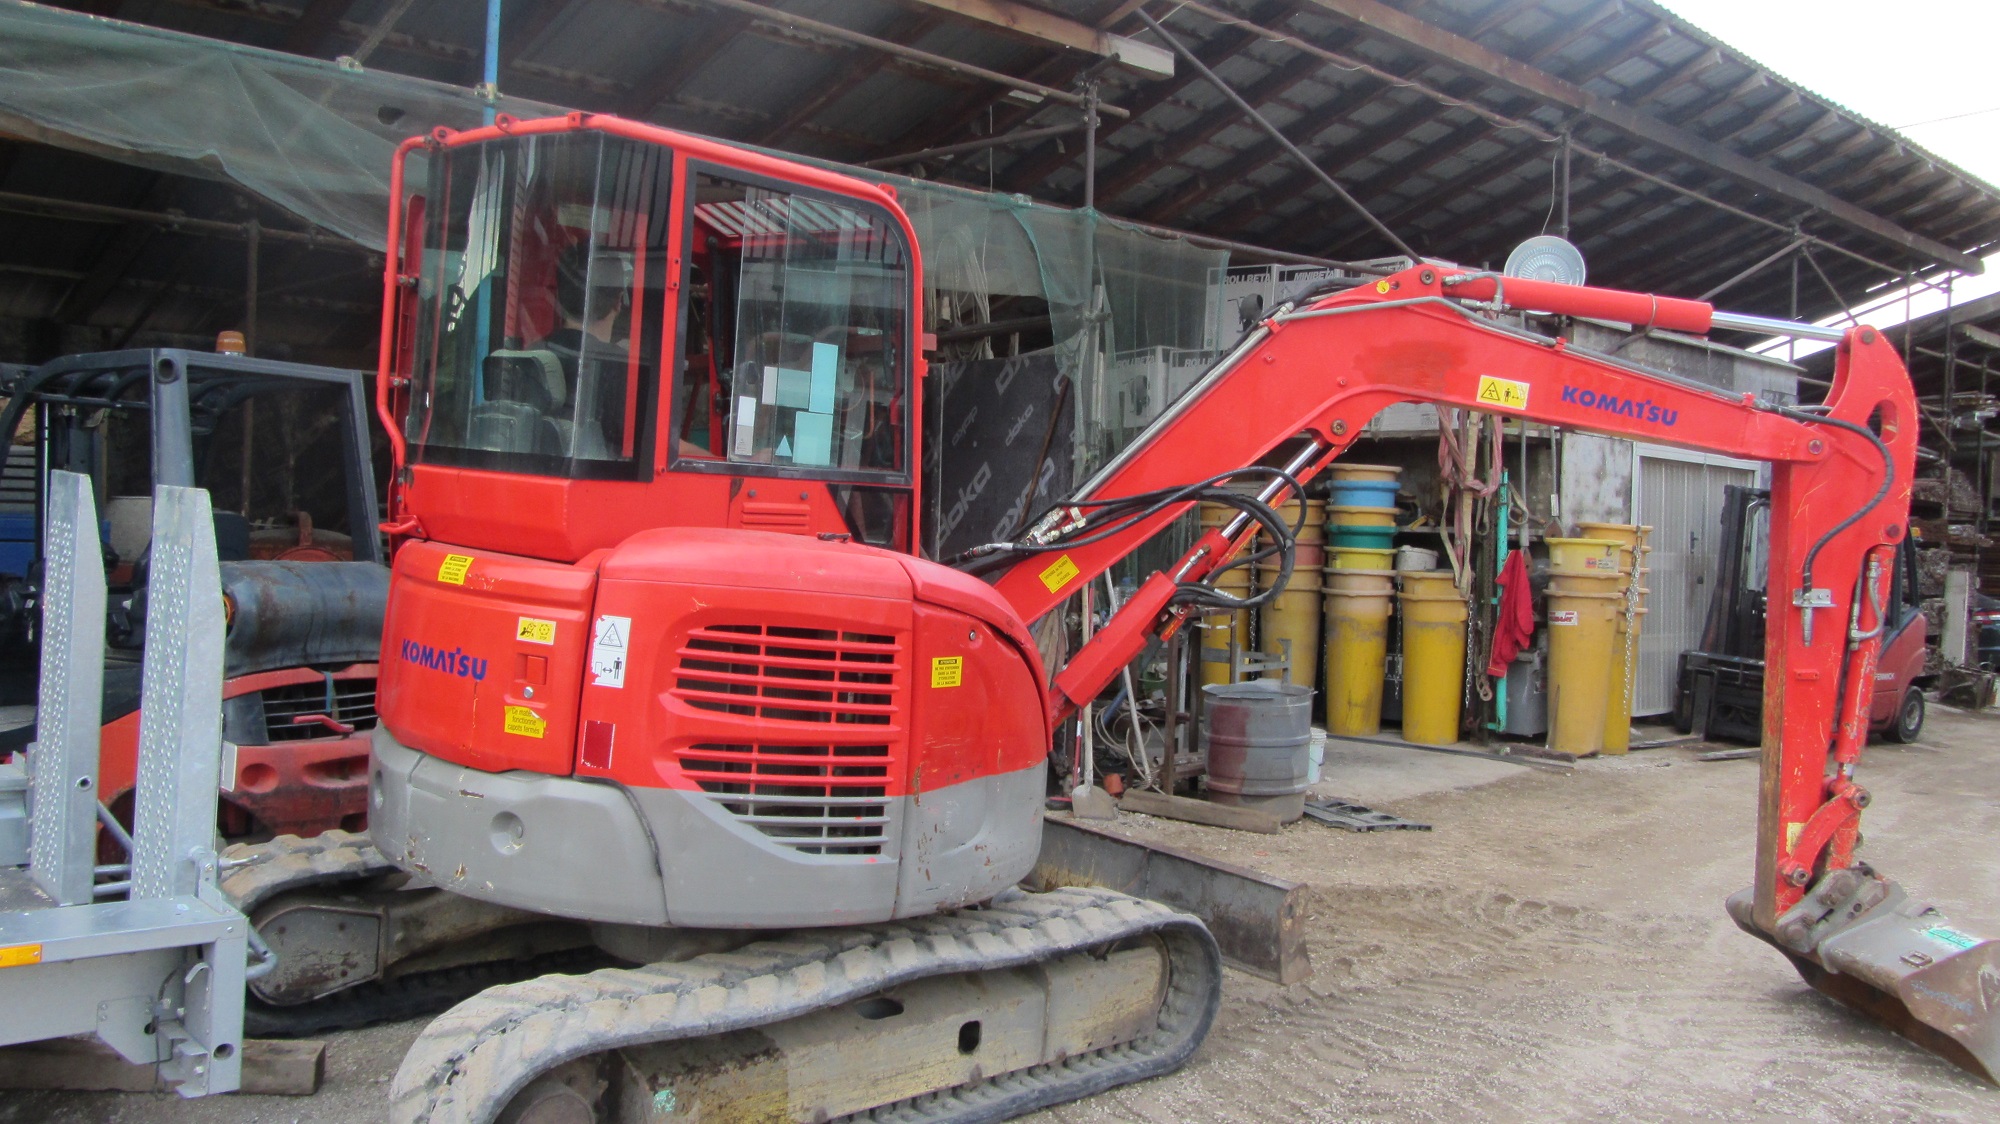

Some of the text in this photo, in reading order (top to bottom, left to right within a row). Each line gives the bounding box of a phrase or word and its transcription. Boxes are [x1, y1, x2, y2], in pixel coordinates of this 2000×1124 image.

[1223, 274, 1271, 285] ROLLBETA
[1184, 356, 1214, 368] ROLLB
[1005, 404, 1034, 446] doka
[1561, 385, 1678, 427] KOMATSU
[401, 638, 487, 681] KOMATSU
